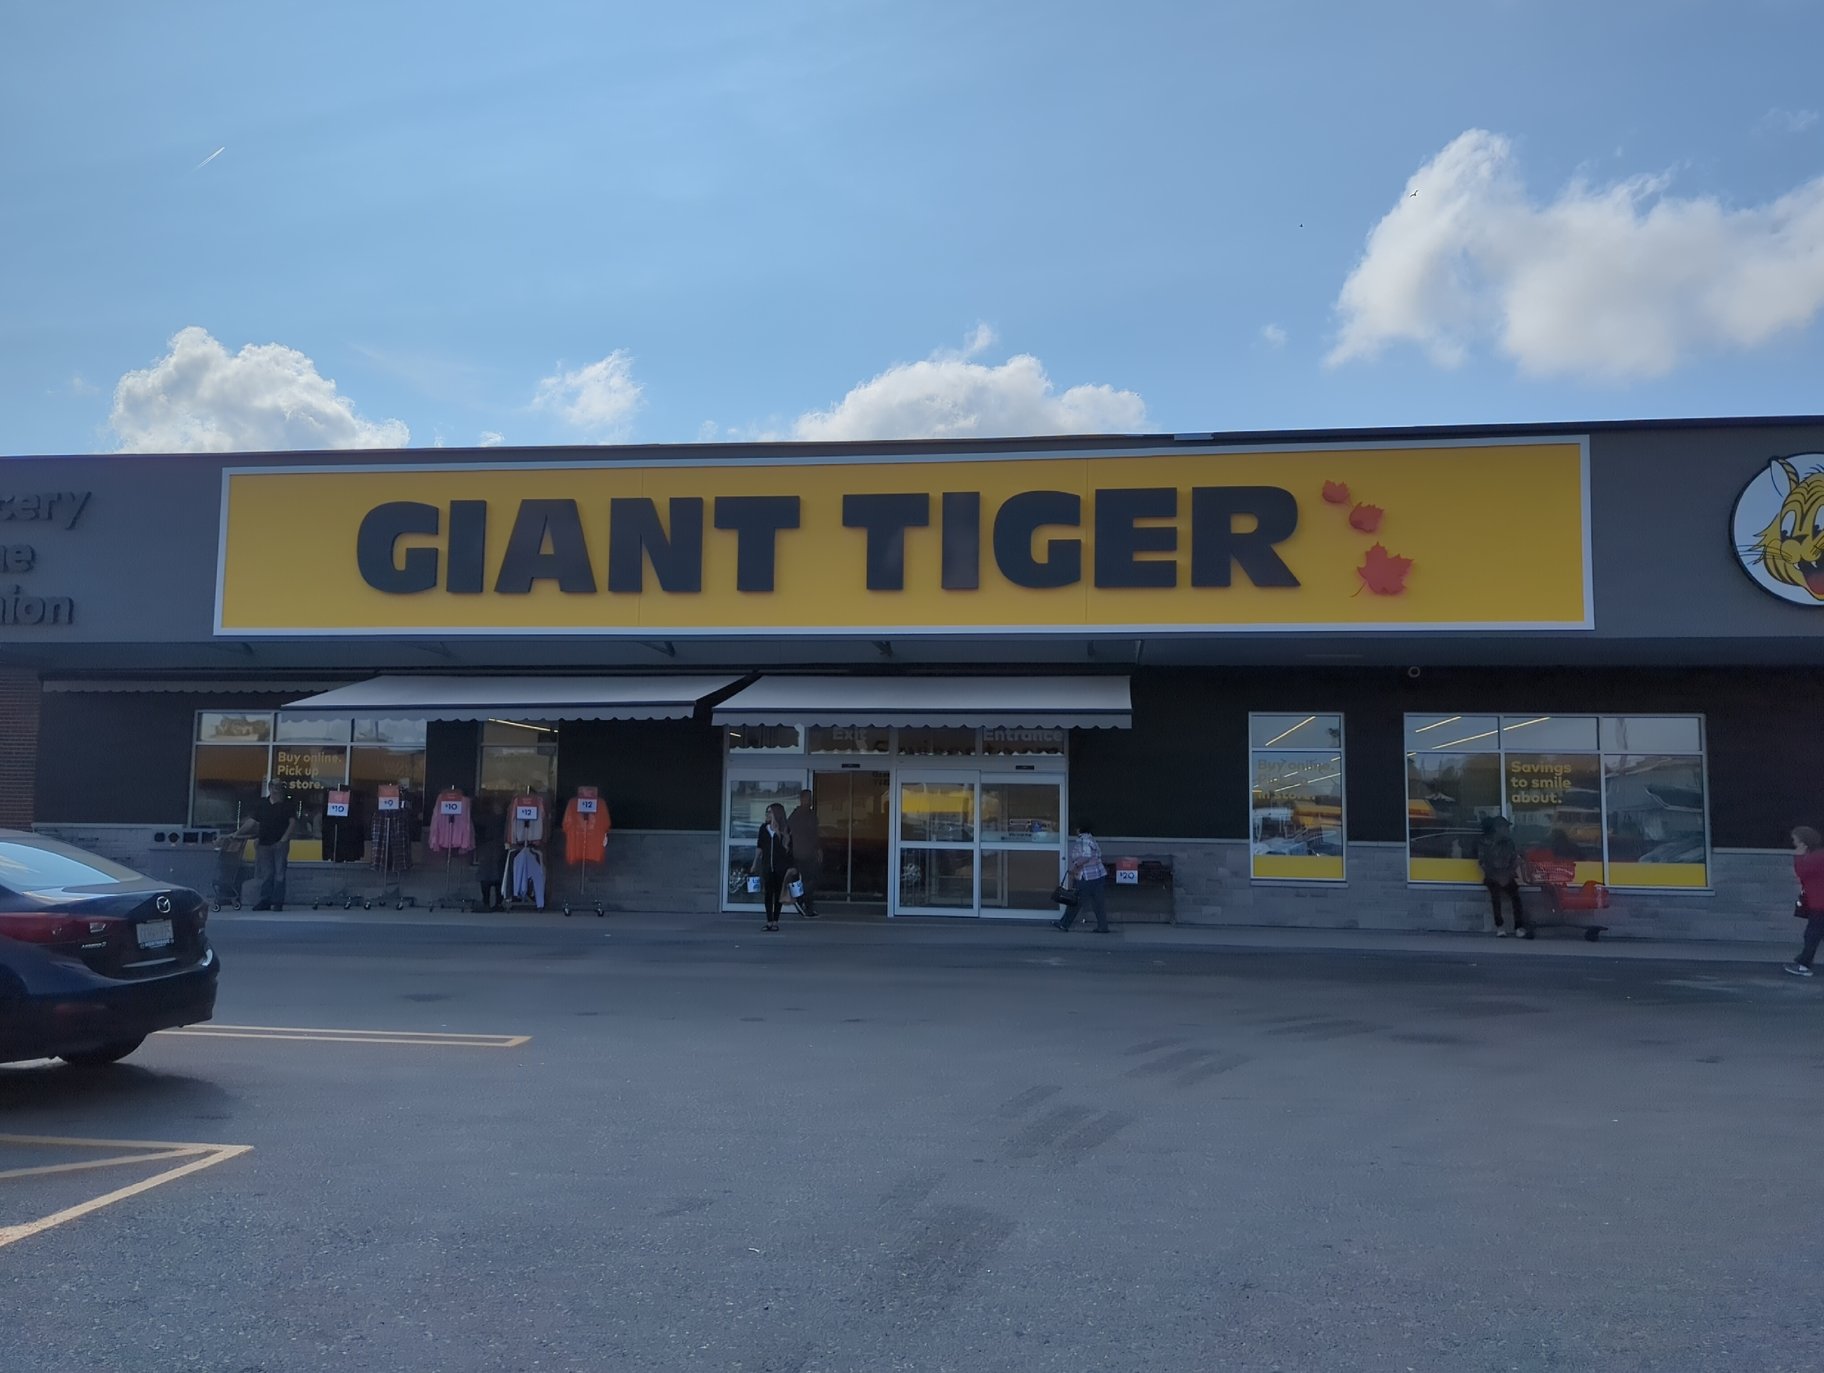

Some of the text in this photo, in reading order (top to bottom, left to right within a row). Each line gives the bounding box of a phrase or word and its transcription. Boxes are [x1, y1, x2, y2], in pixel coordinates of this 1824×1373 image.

[357, 485, 1301, 594] GIANT TIGER
[983, 727, 1063, 741] Entrance
[278, 752, 342, 764] Buy online.
[277, 765, 319, 779] Pick up
[1511, 761, 1572, 776] Savings
[289, 780, 325, 790] store.
[1510, 776, 1572, 789] to smile
[1511, 791, 1563, 804] about.
